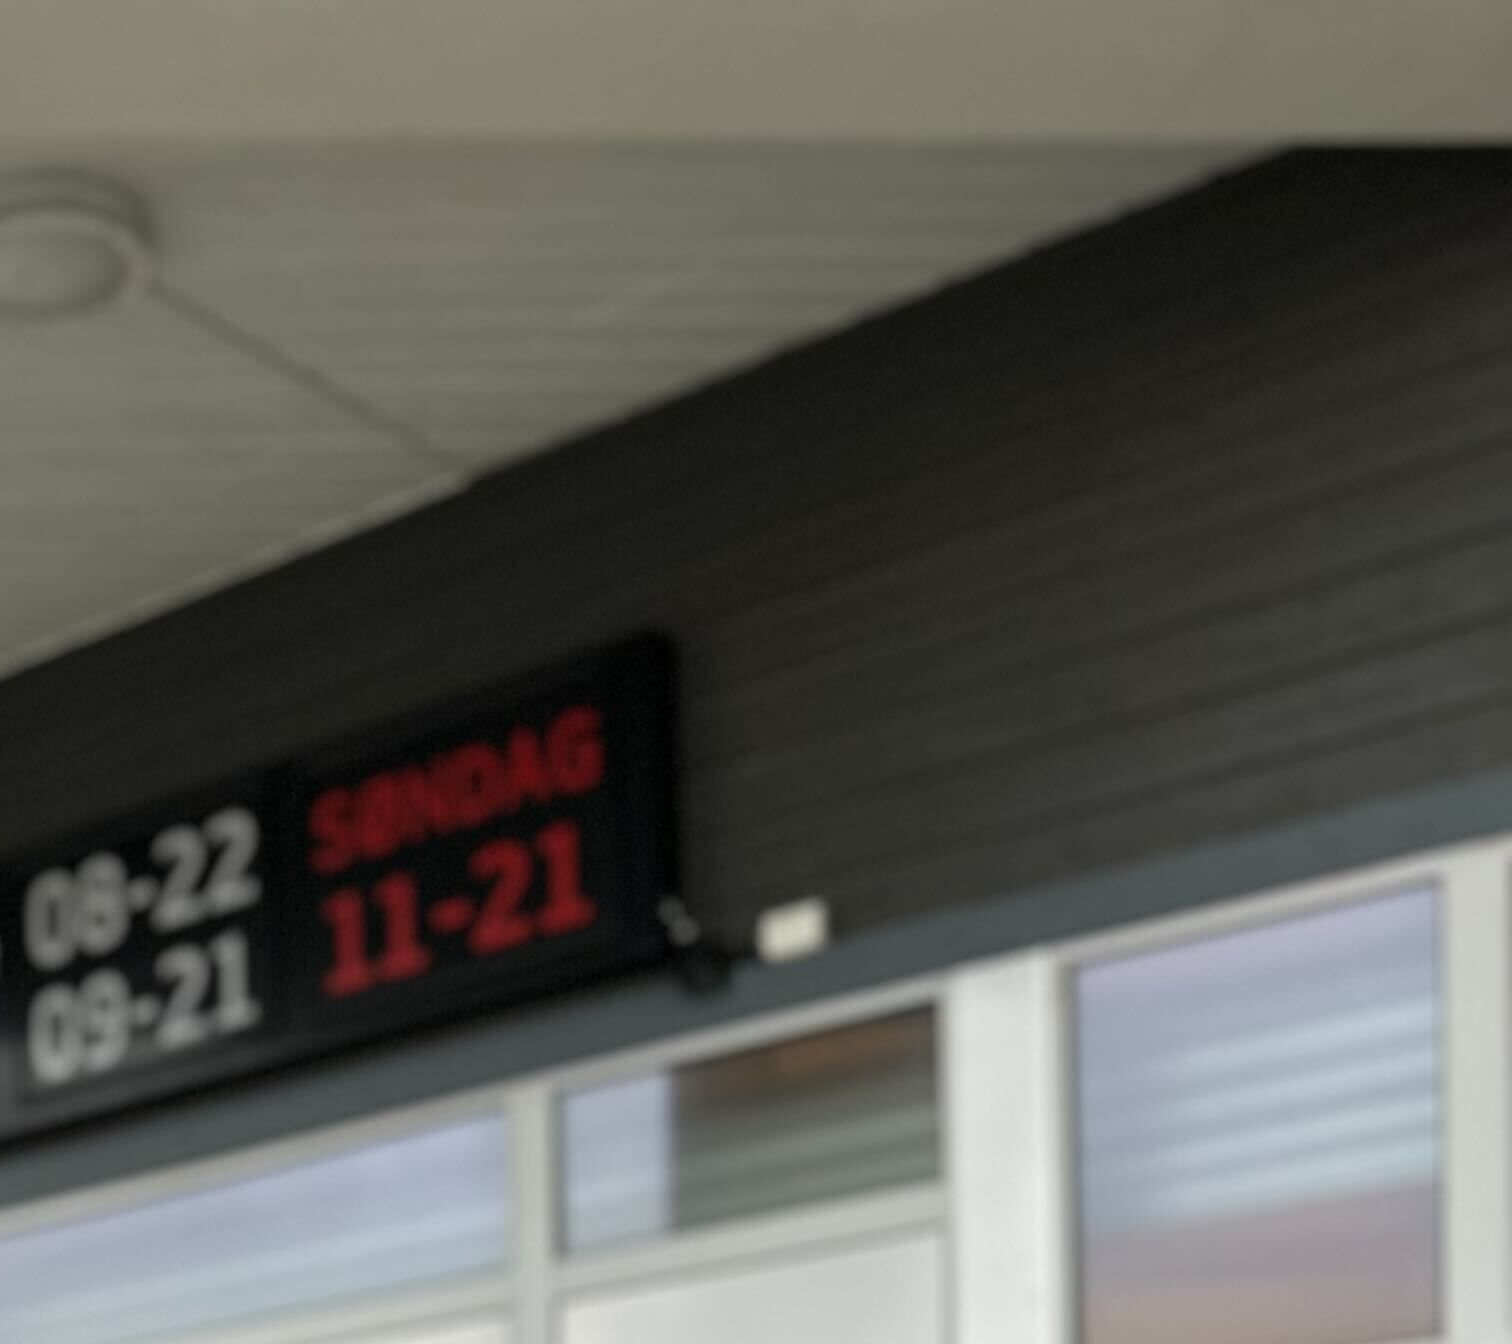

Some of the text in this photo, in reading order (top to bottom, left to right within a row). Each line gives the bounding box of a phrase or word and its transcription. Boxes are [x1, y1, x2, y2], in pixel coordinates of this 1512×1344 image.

[23, 807, 263, 970] 08-22
[320, 818, 599, 999] 11-21
[27, 930, 261, 1084] 09-21
